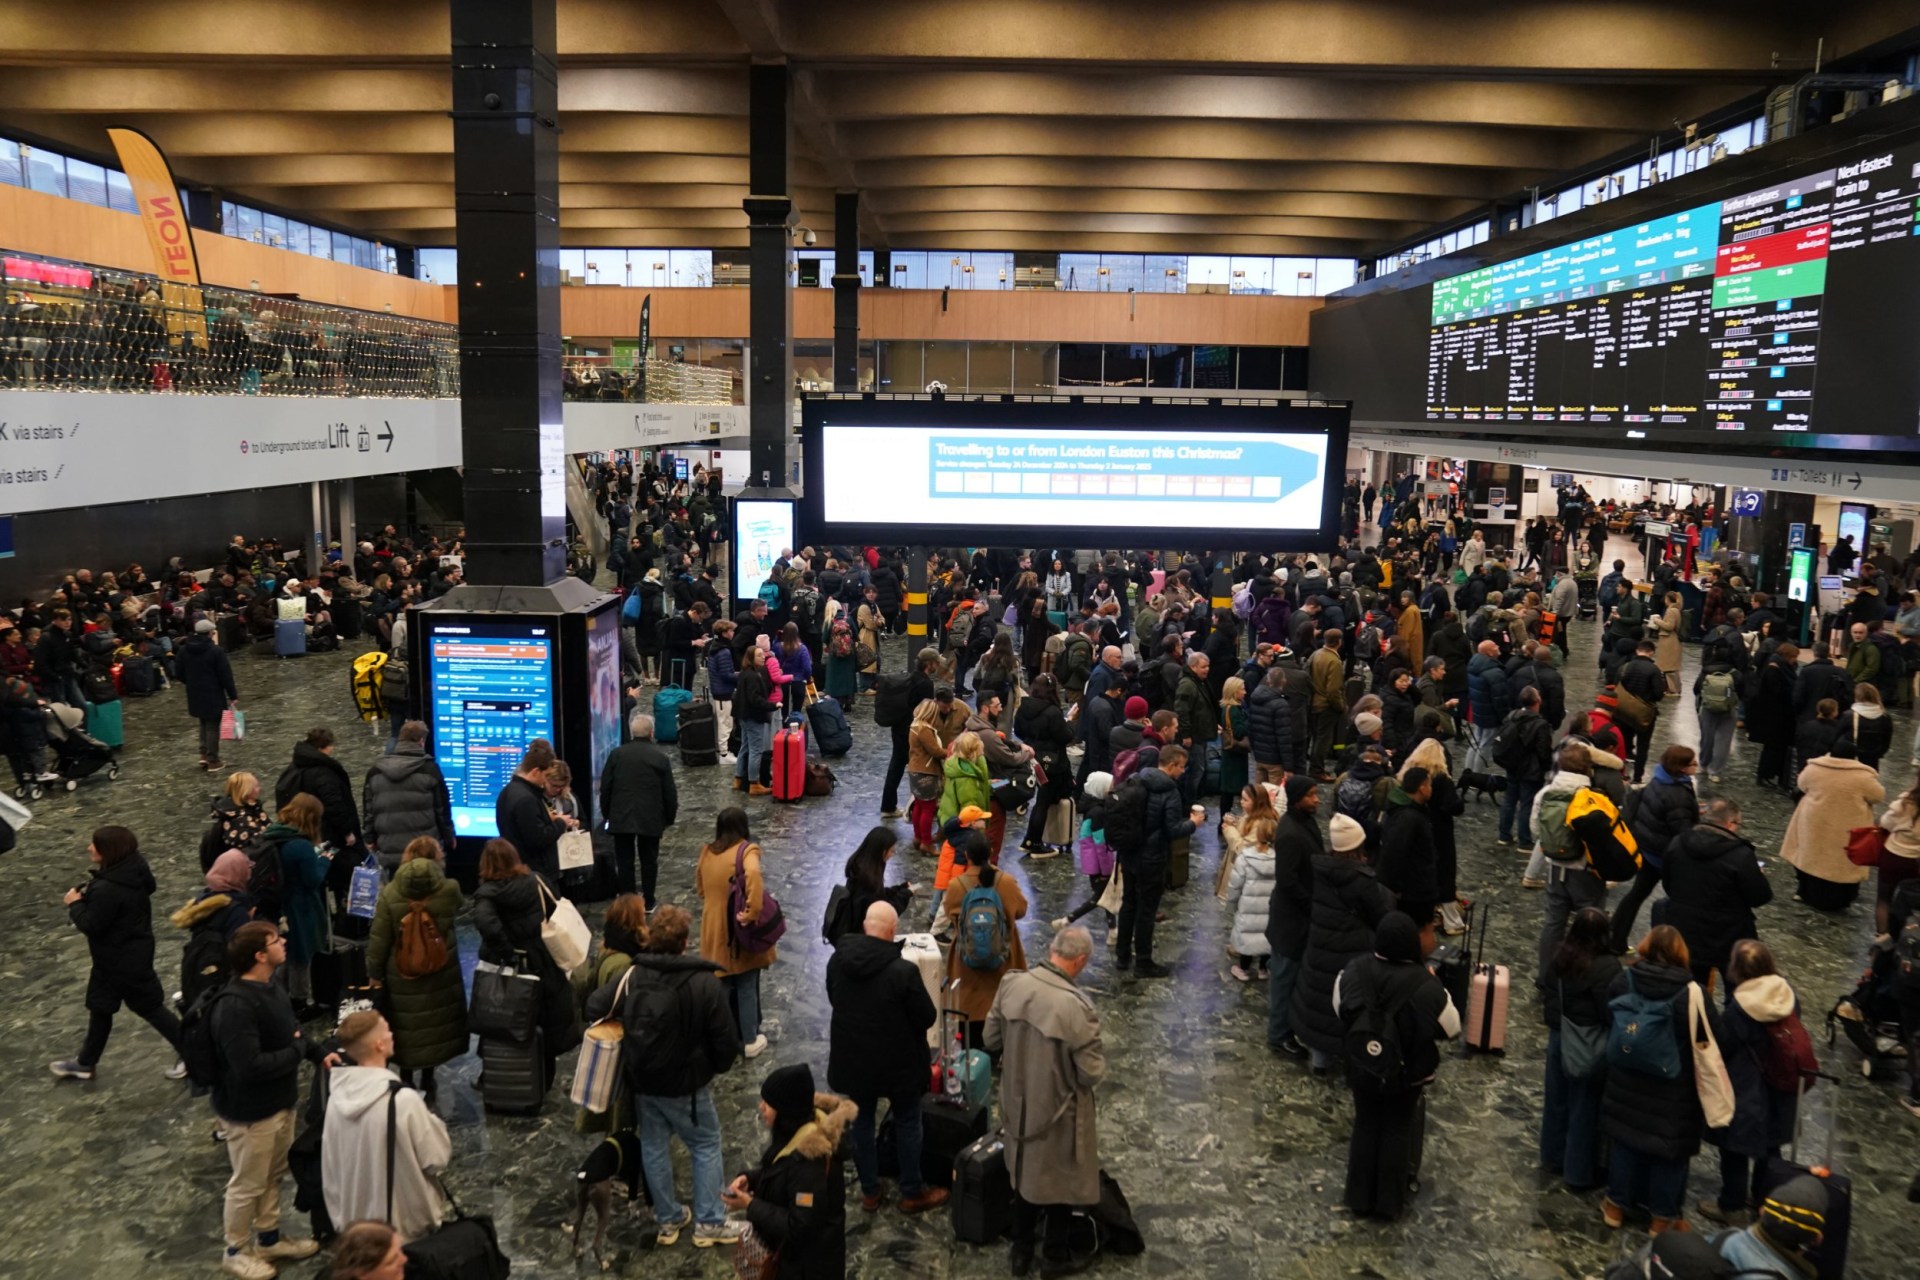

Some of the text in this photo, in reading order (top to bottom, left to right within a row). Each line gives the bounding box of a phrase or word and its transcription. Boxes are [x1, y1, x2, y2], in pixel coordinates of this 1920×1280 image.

[1837, 154, 1894, 180] Next fastest
[1836, 179, 1870, 198] train to
[1722, 199, 1745, 213] Further
[1745, 189, 1780, 207] departures
[150, 196, 190, 276] LEON
[13, 424, 31, 440] via
[33, 424, 64, 440] stairs
[252, 423, 350, 455] to Underground ticket hall Lift
[936, 442, 1243, 460] Travelling to or from London Euston this Christmas?
[16, 467, 48, 484] stairs
[1023, 461, 1052, 469] December
[1078, 462, 1105, 472] Thursday
[1111, 463, 1137, 472] January
[1799, 468, 1827, 484] Toilets
